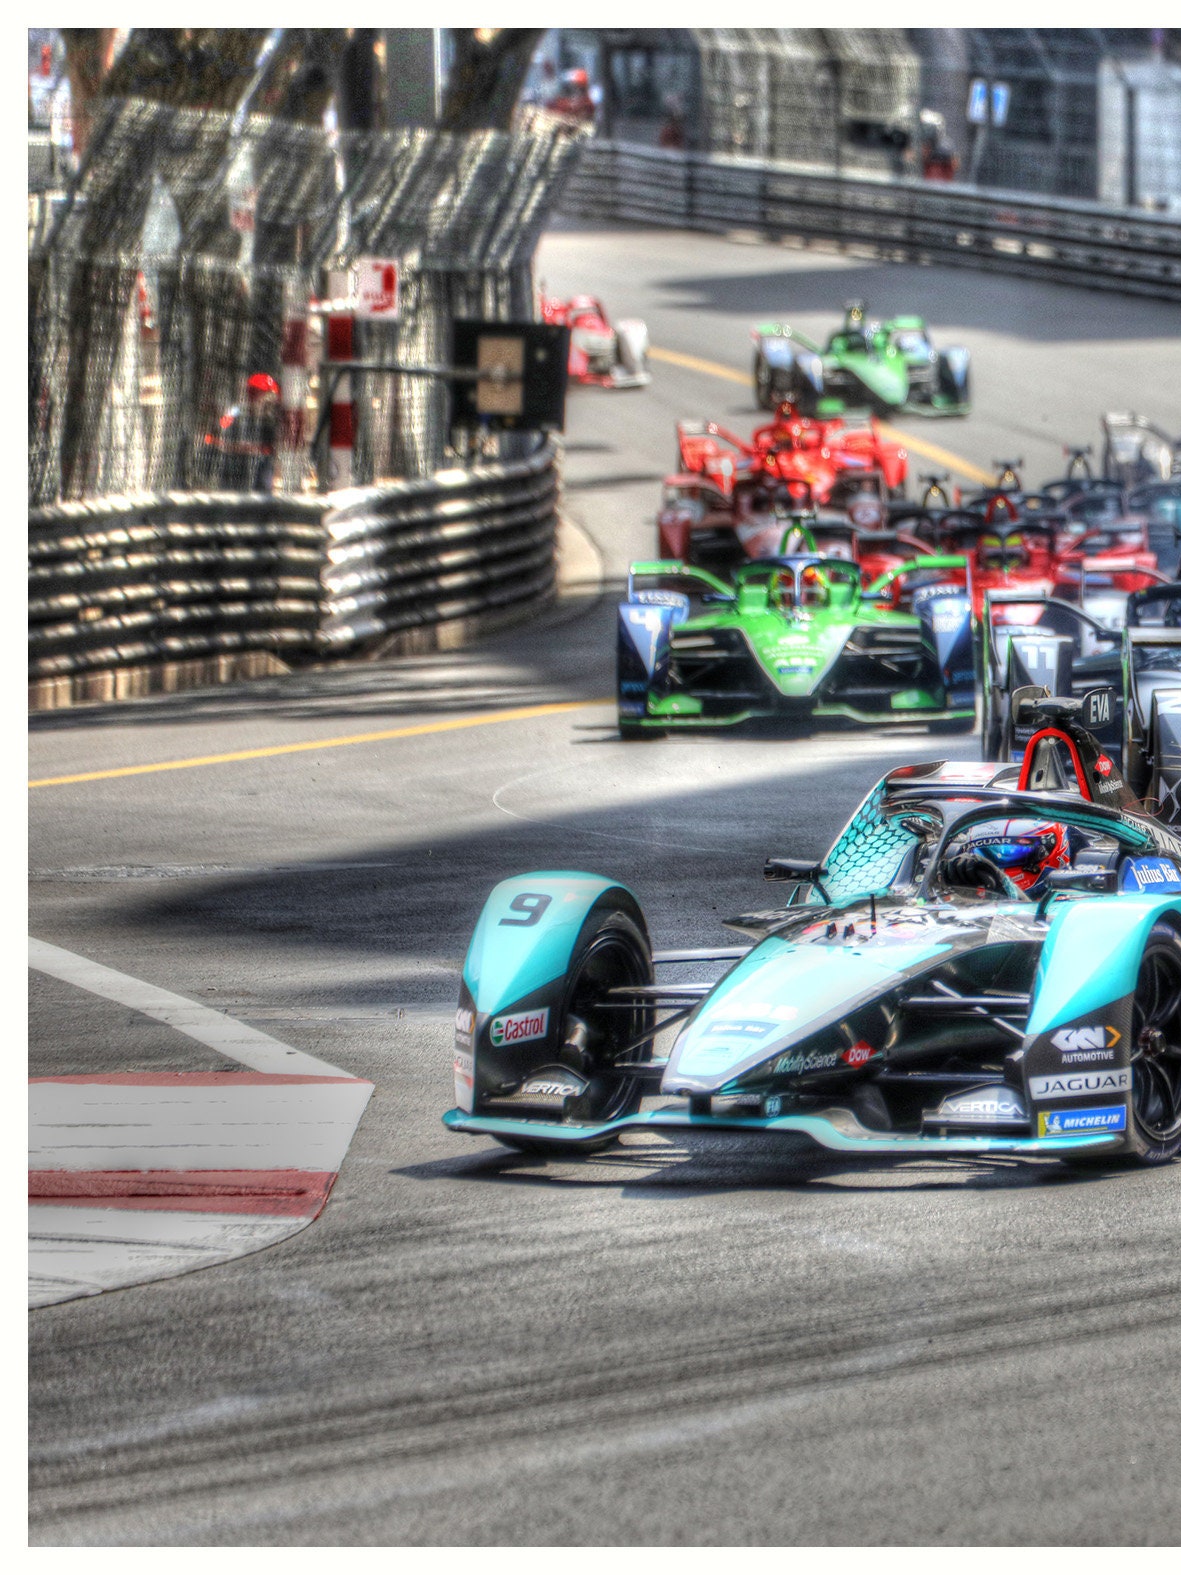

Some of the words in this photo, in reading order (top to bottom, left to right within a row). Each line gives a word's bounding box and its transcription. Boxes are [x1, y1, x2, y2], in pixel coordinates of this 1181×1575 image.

[1022, 646, 1055, 669] 11
[1090, 693, 1110, 723] EVA
[1131, 864, 1165, 889] Julius
[498, 893, 553, 927] 9
[505, 1013, 545, 1041] Castrol
[1061, 1049, 1114, 1064] AUTOMOTIVE
[1037, 1074, 1128, 1094] JAGUAR
[1063, 1114, 1121, 1129] MICHELIN
